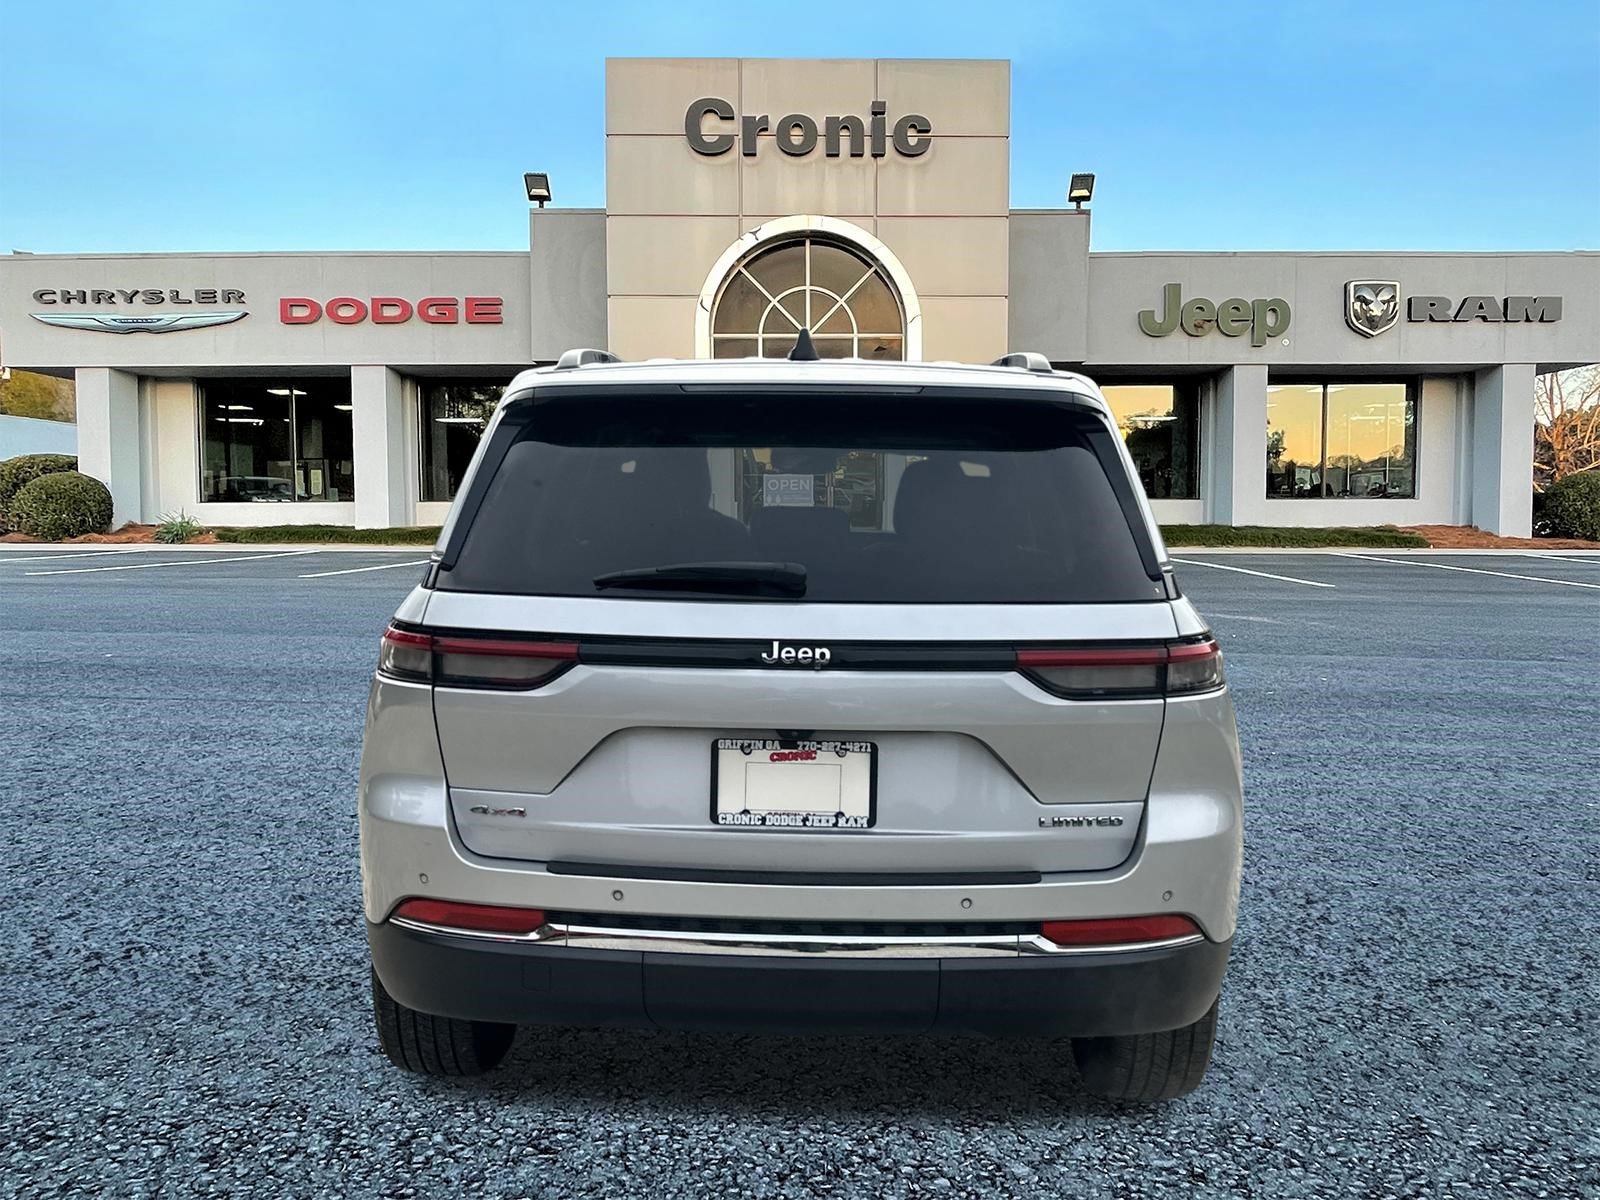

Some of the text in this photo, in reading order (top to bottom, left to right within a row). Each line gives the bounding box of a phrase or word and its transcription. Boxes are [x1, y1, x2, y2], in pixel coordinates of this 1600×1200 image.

[685, 97, 932, 157] Cronic
[33, 288, 246, 305] CHRYSLER
[280, 297, 504, 325] DODGE
[1138, 282, 1291, 347] Jeep
[1407, 296, 1563, 322] RAM
[767, 479, 810, 491] OPEN
[761, 641, 831, 669] Jeep
[718, 739, 763, 750] GRIFFIN
[766, 740, 781, 751] GA
[769, 751, 817, 762] CRONIC
[718, 813, 762, 825] CRONIC
[765, 814, 803, 826] DODGE
[805, 815, 836, 827] JEEP
[838, 816, 868, 828] RAM
[1039, 816, 1124, 828] LIMITED
